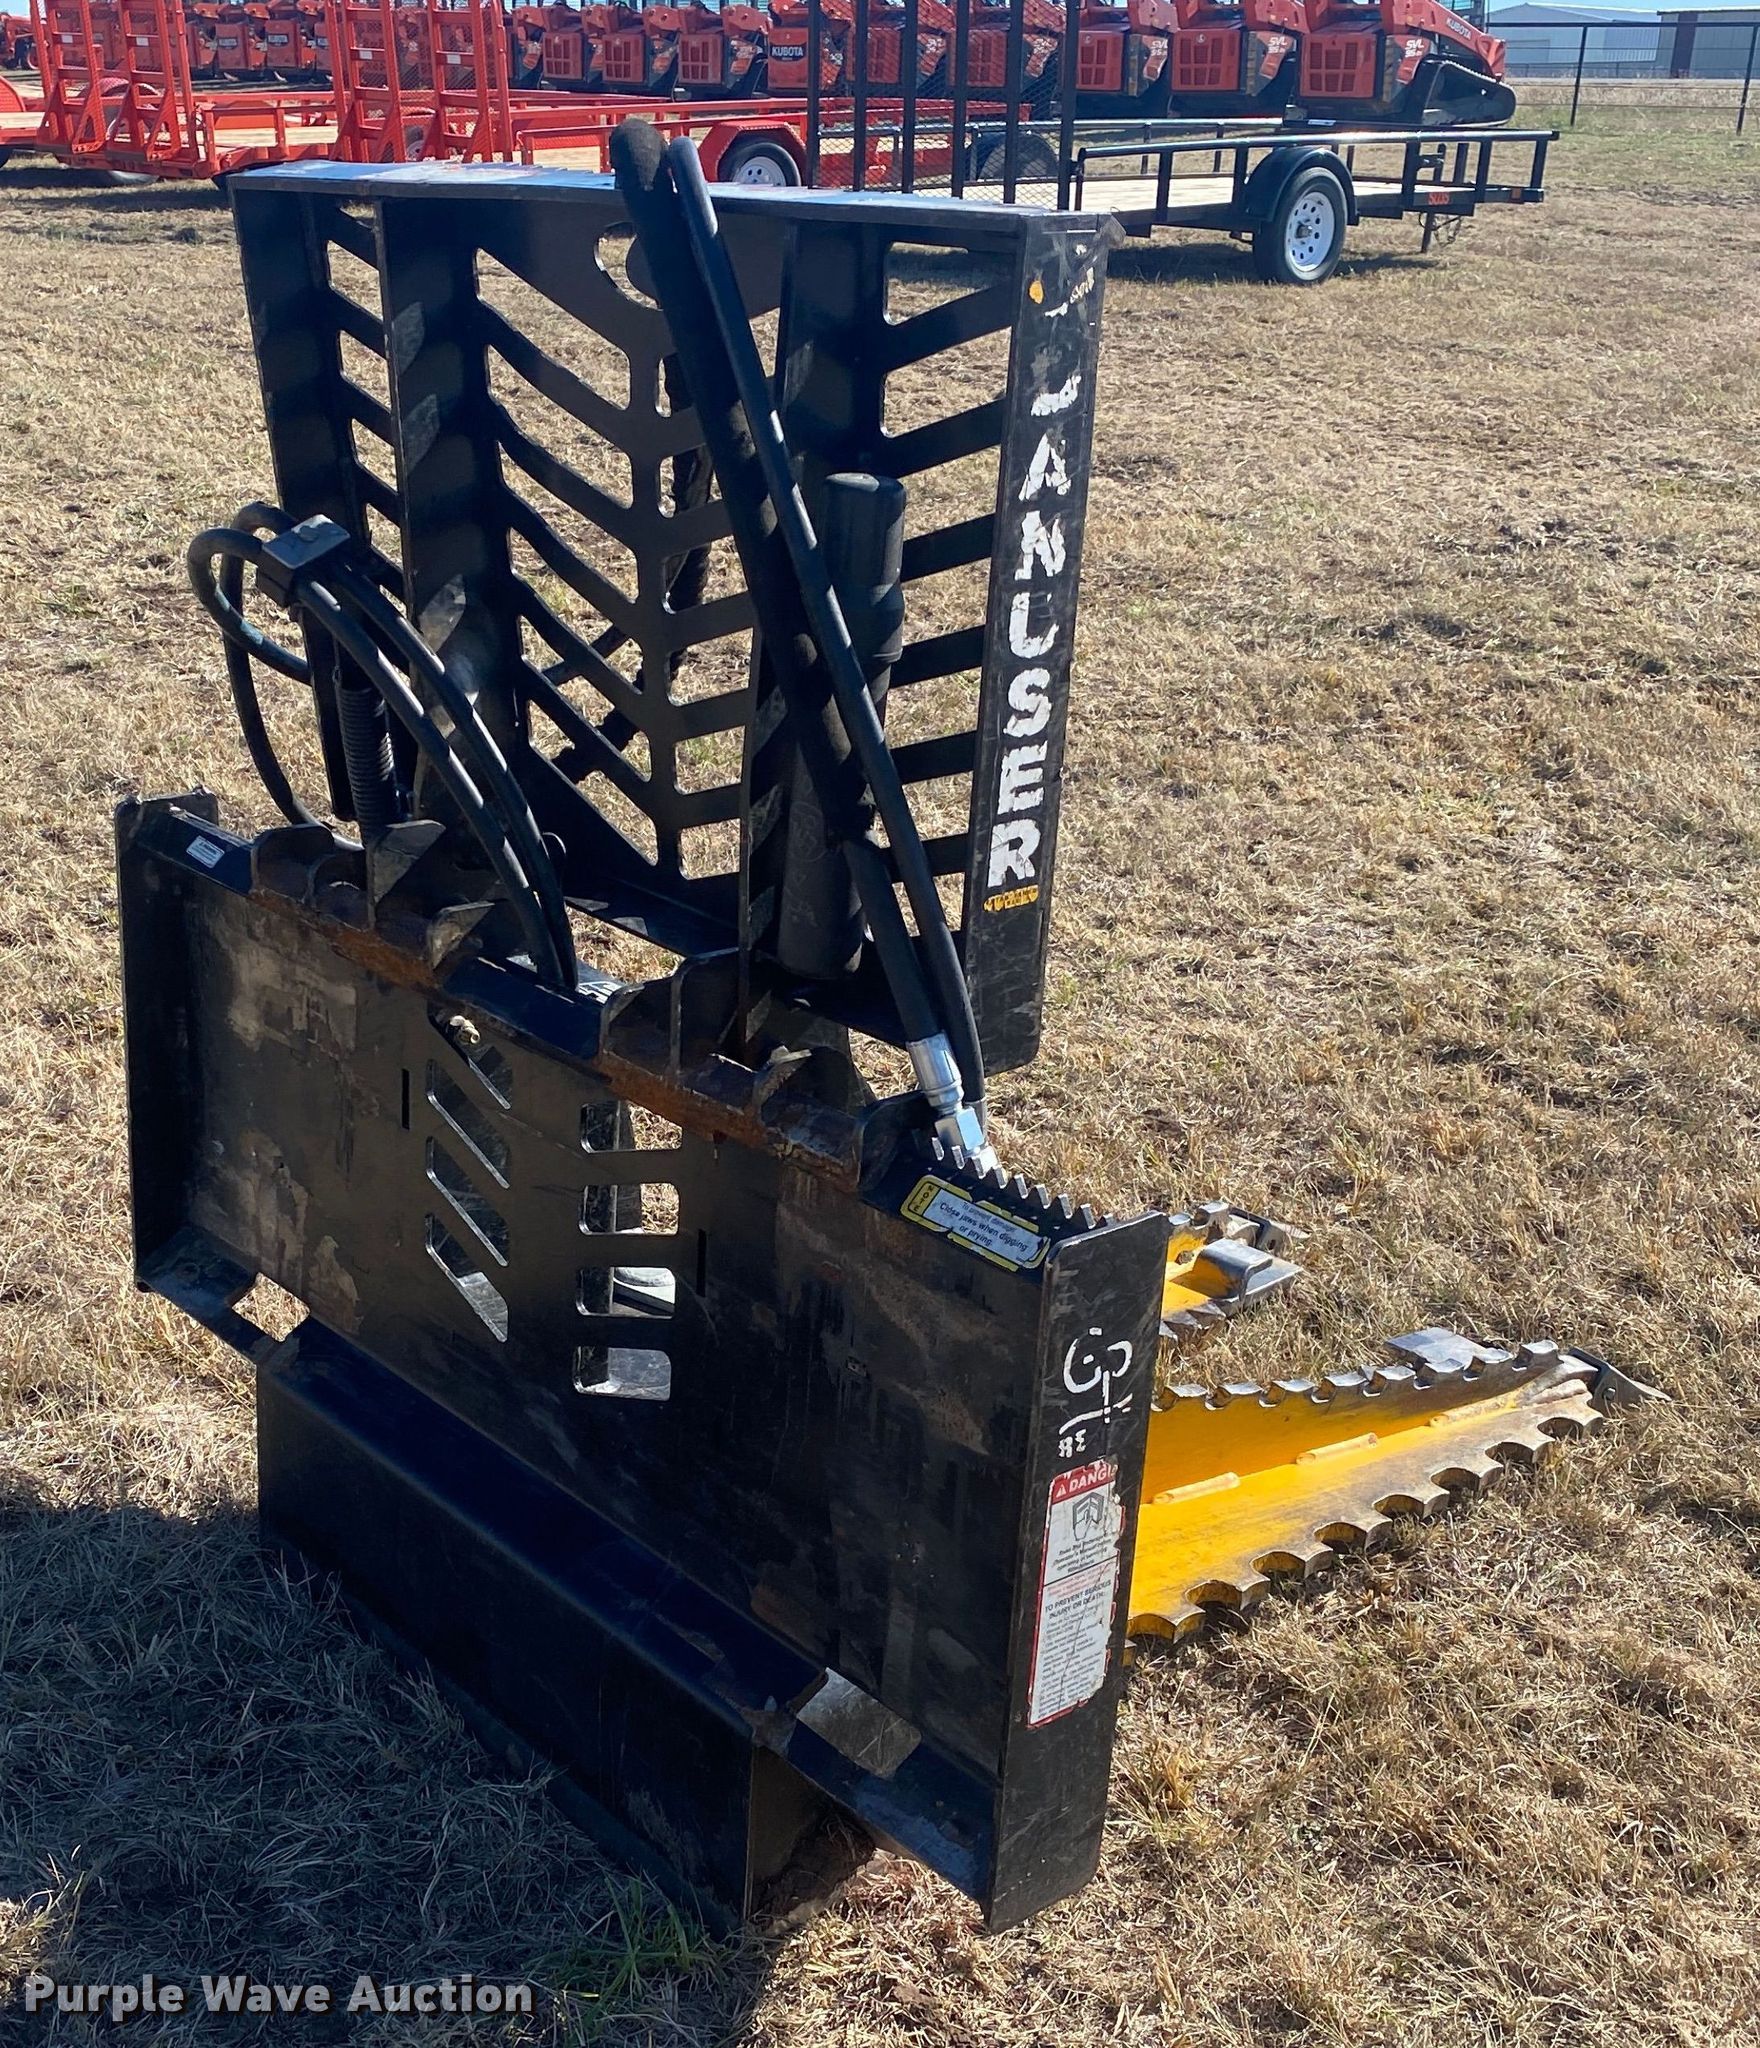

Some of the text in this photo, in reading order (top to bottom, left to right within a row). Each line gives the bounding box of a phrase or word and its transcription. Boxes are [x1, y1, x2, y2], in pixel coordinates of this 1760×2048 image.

[1446, 17, 1472, 40] KUBOTA
[1405, 39, 1424, 49] SVL
[772, 46, 804, 56] KUBOTA
[959, 1224, 968, 1233] or
[978, 1222, 999, 1237] when
[999, 1232, 1028, 1252] digging
